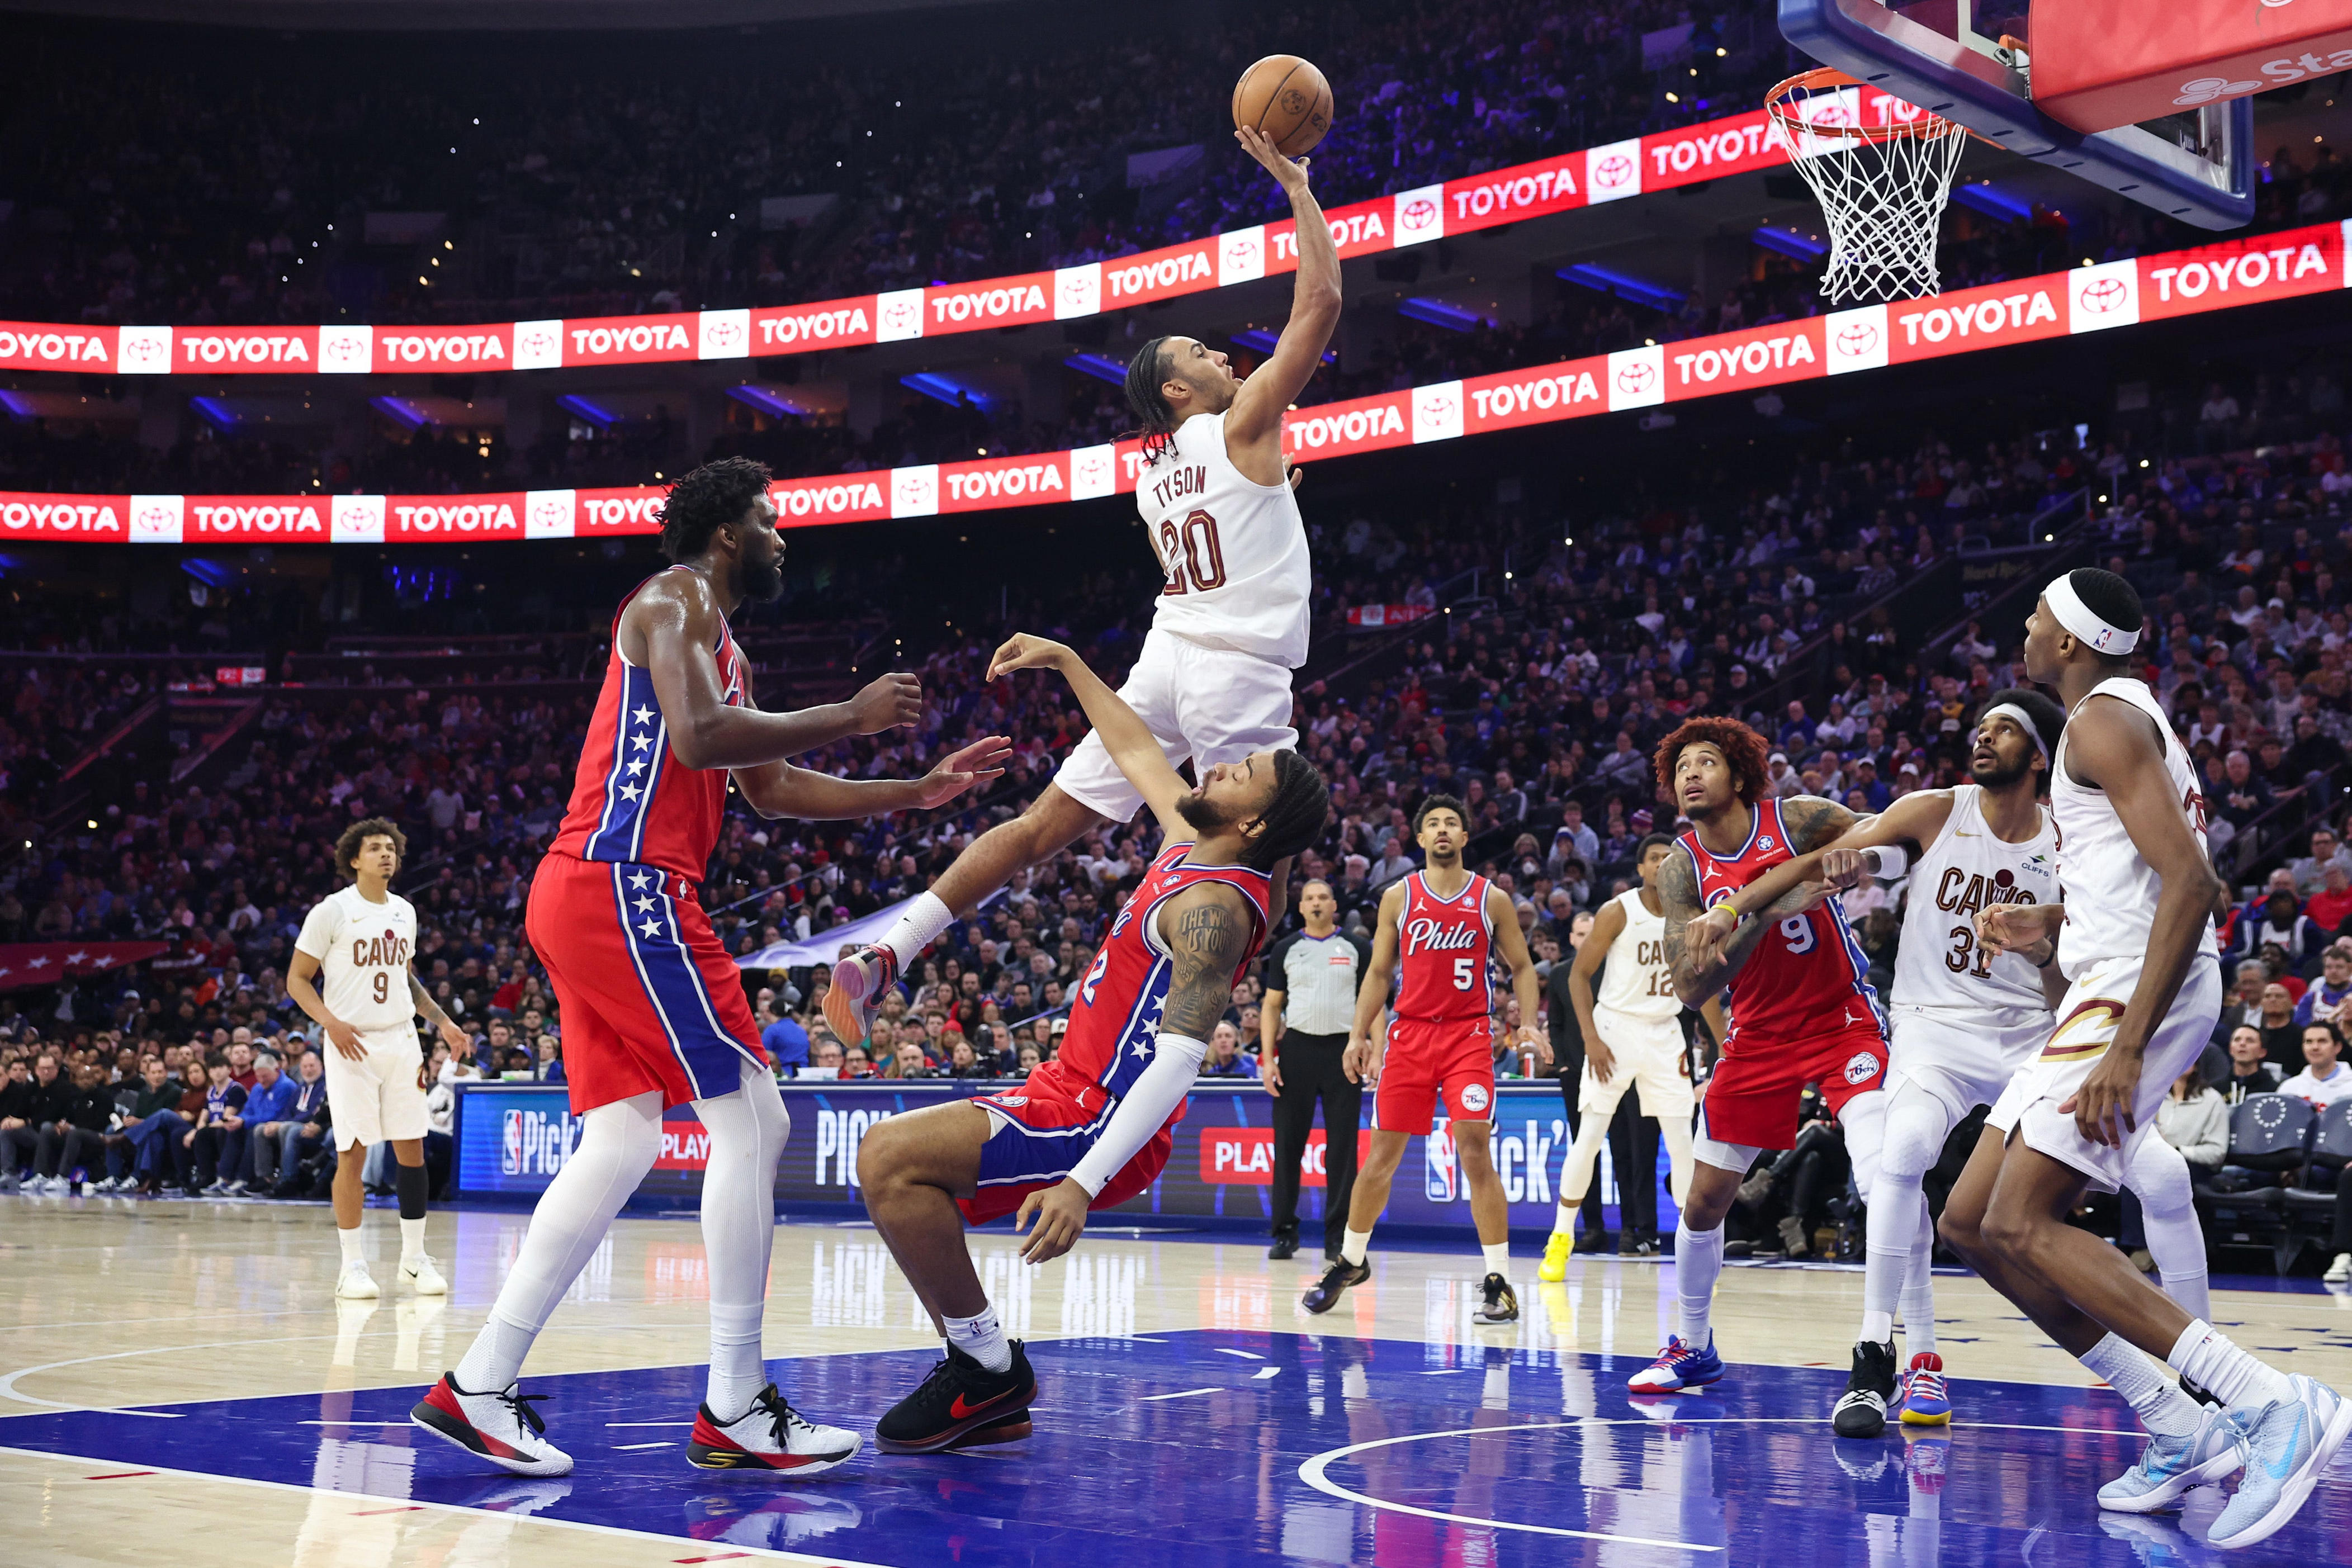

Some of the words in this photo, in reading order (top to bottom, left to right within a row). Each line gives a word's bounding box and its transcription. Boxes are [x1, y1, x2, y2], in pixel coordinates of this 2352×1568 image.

[2261, 49, 2352, 82] Sta
[0, 331, 108, 362] OYOTA
[182, 337, 309, 362] TOYOTA
[382, 335, 505, 362] TOYOTA
[571, 325, 689, 354] TOYOTA
[759, 308, 869, 344] TOYOTA
[931, 285, 1046, 323] TOYOTA
[1108, 252, 1212, 297] TOYOTA
[1454, 169, 1576, 218] TOYOTA
[1652, 124, 1786, 174] TOYOTA
[0, 503, 119, 530] OYOTA
[194, 506, 321, 532] TOYOTA
[395, 504, 516, 531] TOYOTA
[584, 497, 665, 524] TOYO
[773, 483, 883, 517] TOYOTA
[947, 464, 1063, 500] TOYOTA
[1288, 405, 1404, 450] TOYOTA
[1471, 372, 1599, 418] TOYOTA
[1674, 334, 1815, 384] TOYOTA
[1899, 291, 2057, 345] TOYOTA
[2151, 245, 2327, 301] TOYOTA
[1153, 466, 1206, 508] TYSON
[1161, 509, 1226, 595] 20
[1756, 846, 1785, 861] crypto.com
[2022, 863, 2049, 877] CLIFFS
[1182, 908, 1205, 932] THE
[1781, 913, 1816, 955] 9
[354, 937, 408, 967] CAVS
[1187, 929, 1202, 952] IS
[1407, 918, 1477, 956] Phila
[1638, 940, 1667, 965] CA
[373, 972, 389, 1004] 9
[1454, 958, 1474, 991] 5
[1646, 970, 1674, 997] 12
[1849, 1064, 1874, 1079] 76ers
[661, 1134, 710, 1160] PLAY
[816, 1110, 891, 1187] PIC
